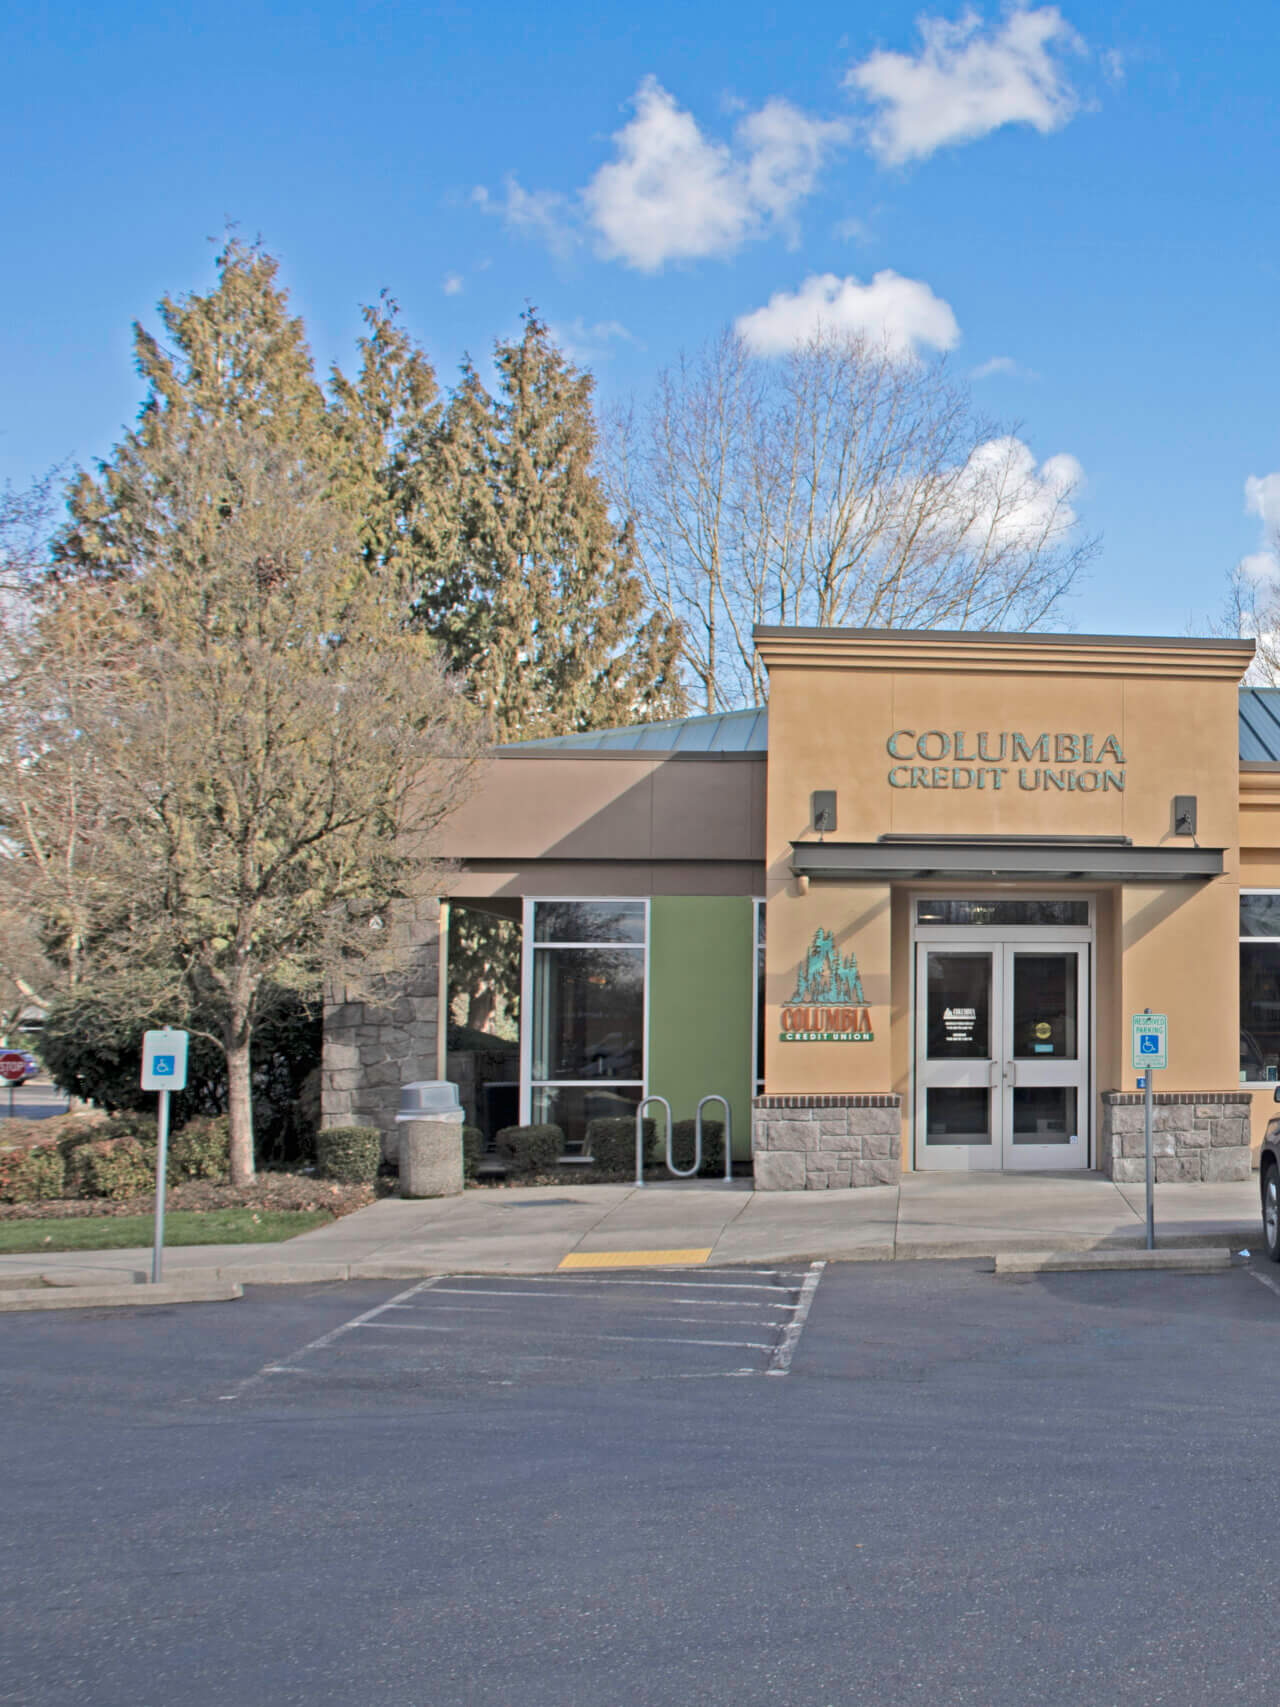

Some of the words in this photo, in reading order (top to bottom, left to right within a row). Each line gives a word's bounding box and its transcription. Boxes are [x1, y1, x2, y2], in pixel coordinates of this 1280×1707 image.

[886, 730, 1127, 764] COLUMBIA
[887, 765, 1008, 790] CREDIT
[1018, 768, 1126, 792] UNION
[781, 1008, 872, 1032] COLUMBIA
[0, 1061, 24, 1073] STOP
